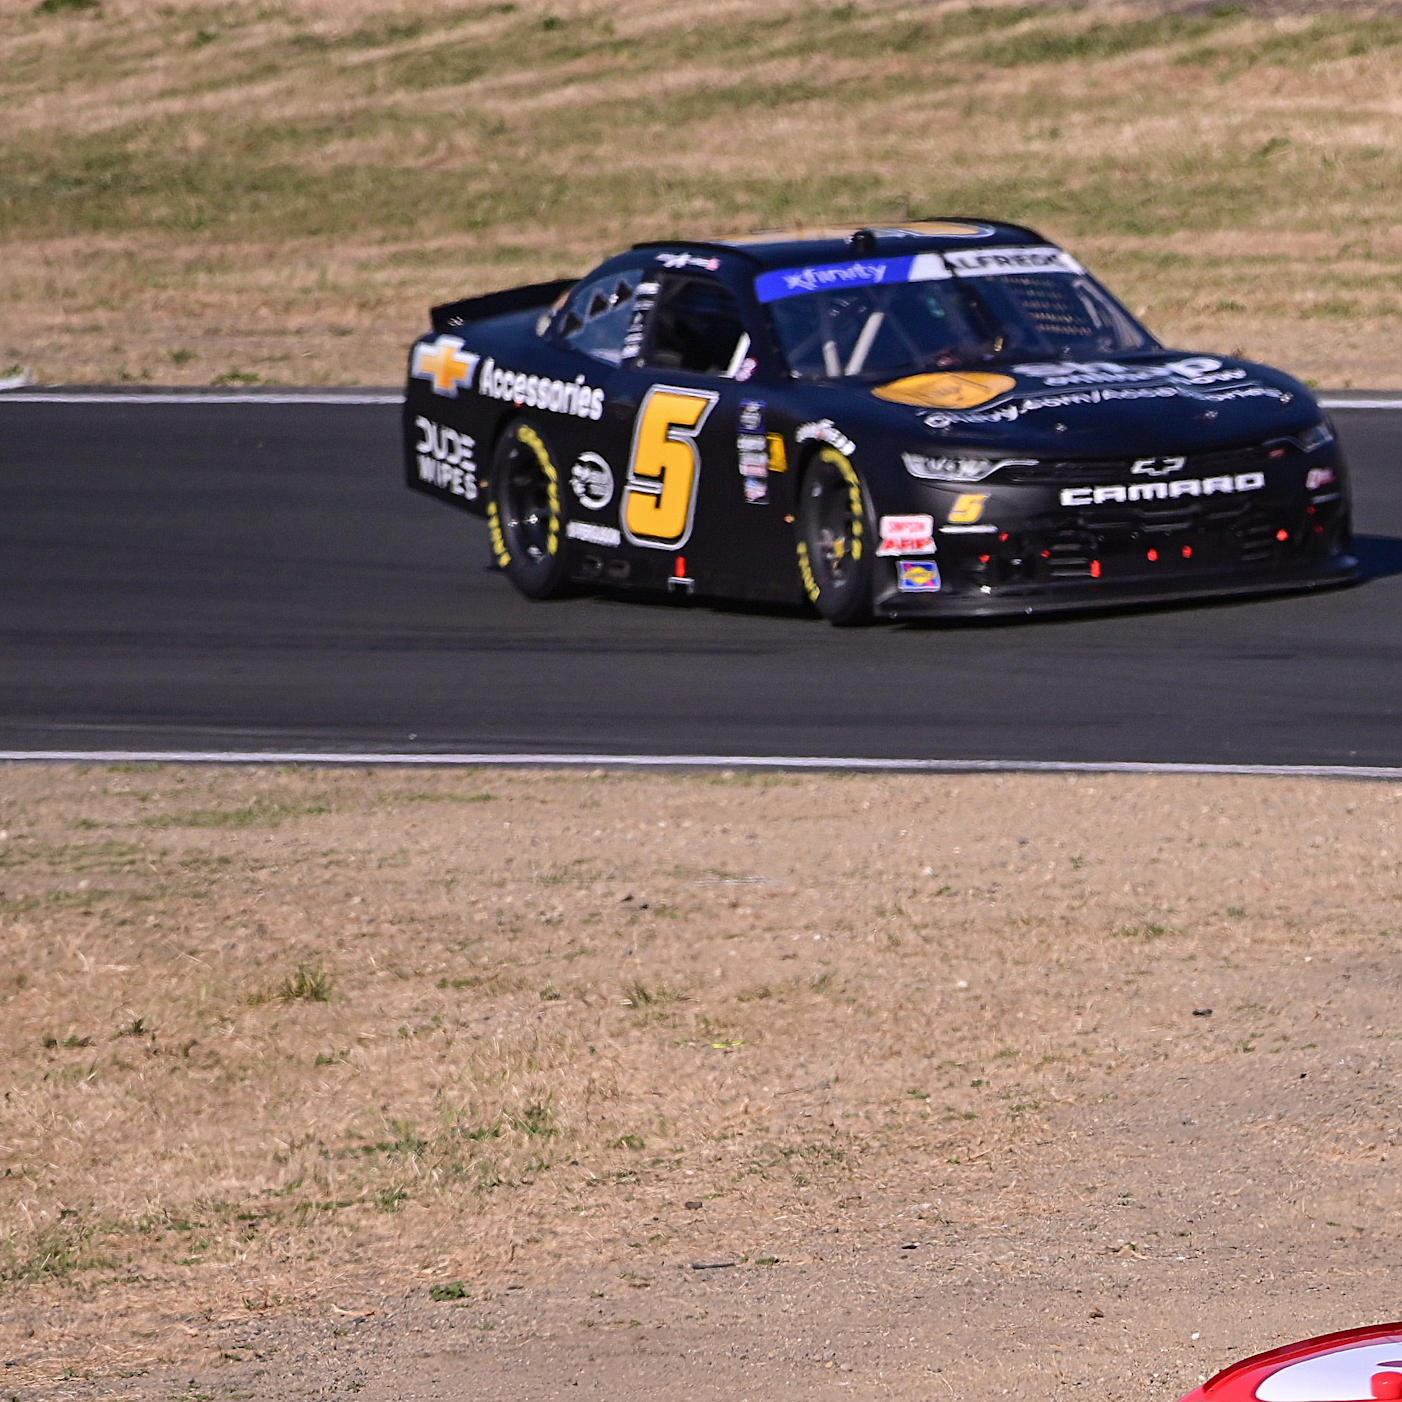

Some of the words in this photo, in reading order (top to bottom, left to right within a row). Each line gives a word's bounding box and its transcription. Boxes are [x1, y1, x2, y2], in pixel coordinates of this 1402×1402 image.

[784, 262, 886, 291] xfinity
[479, 357, 604, 421] Accessories
[416, 415, 476, 472] DUDE
[620, 384, 719, 550] 5
[1060, 471, 1265, 506] CAMARO
[948, 493, 991, 523] 5
